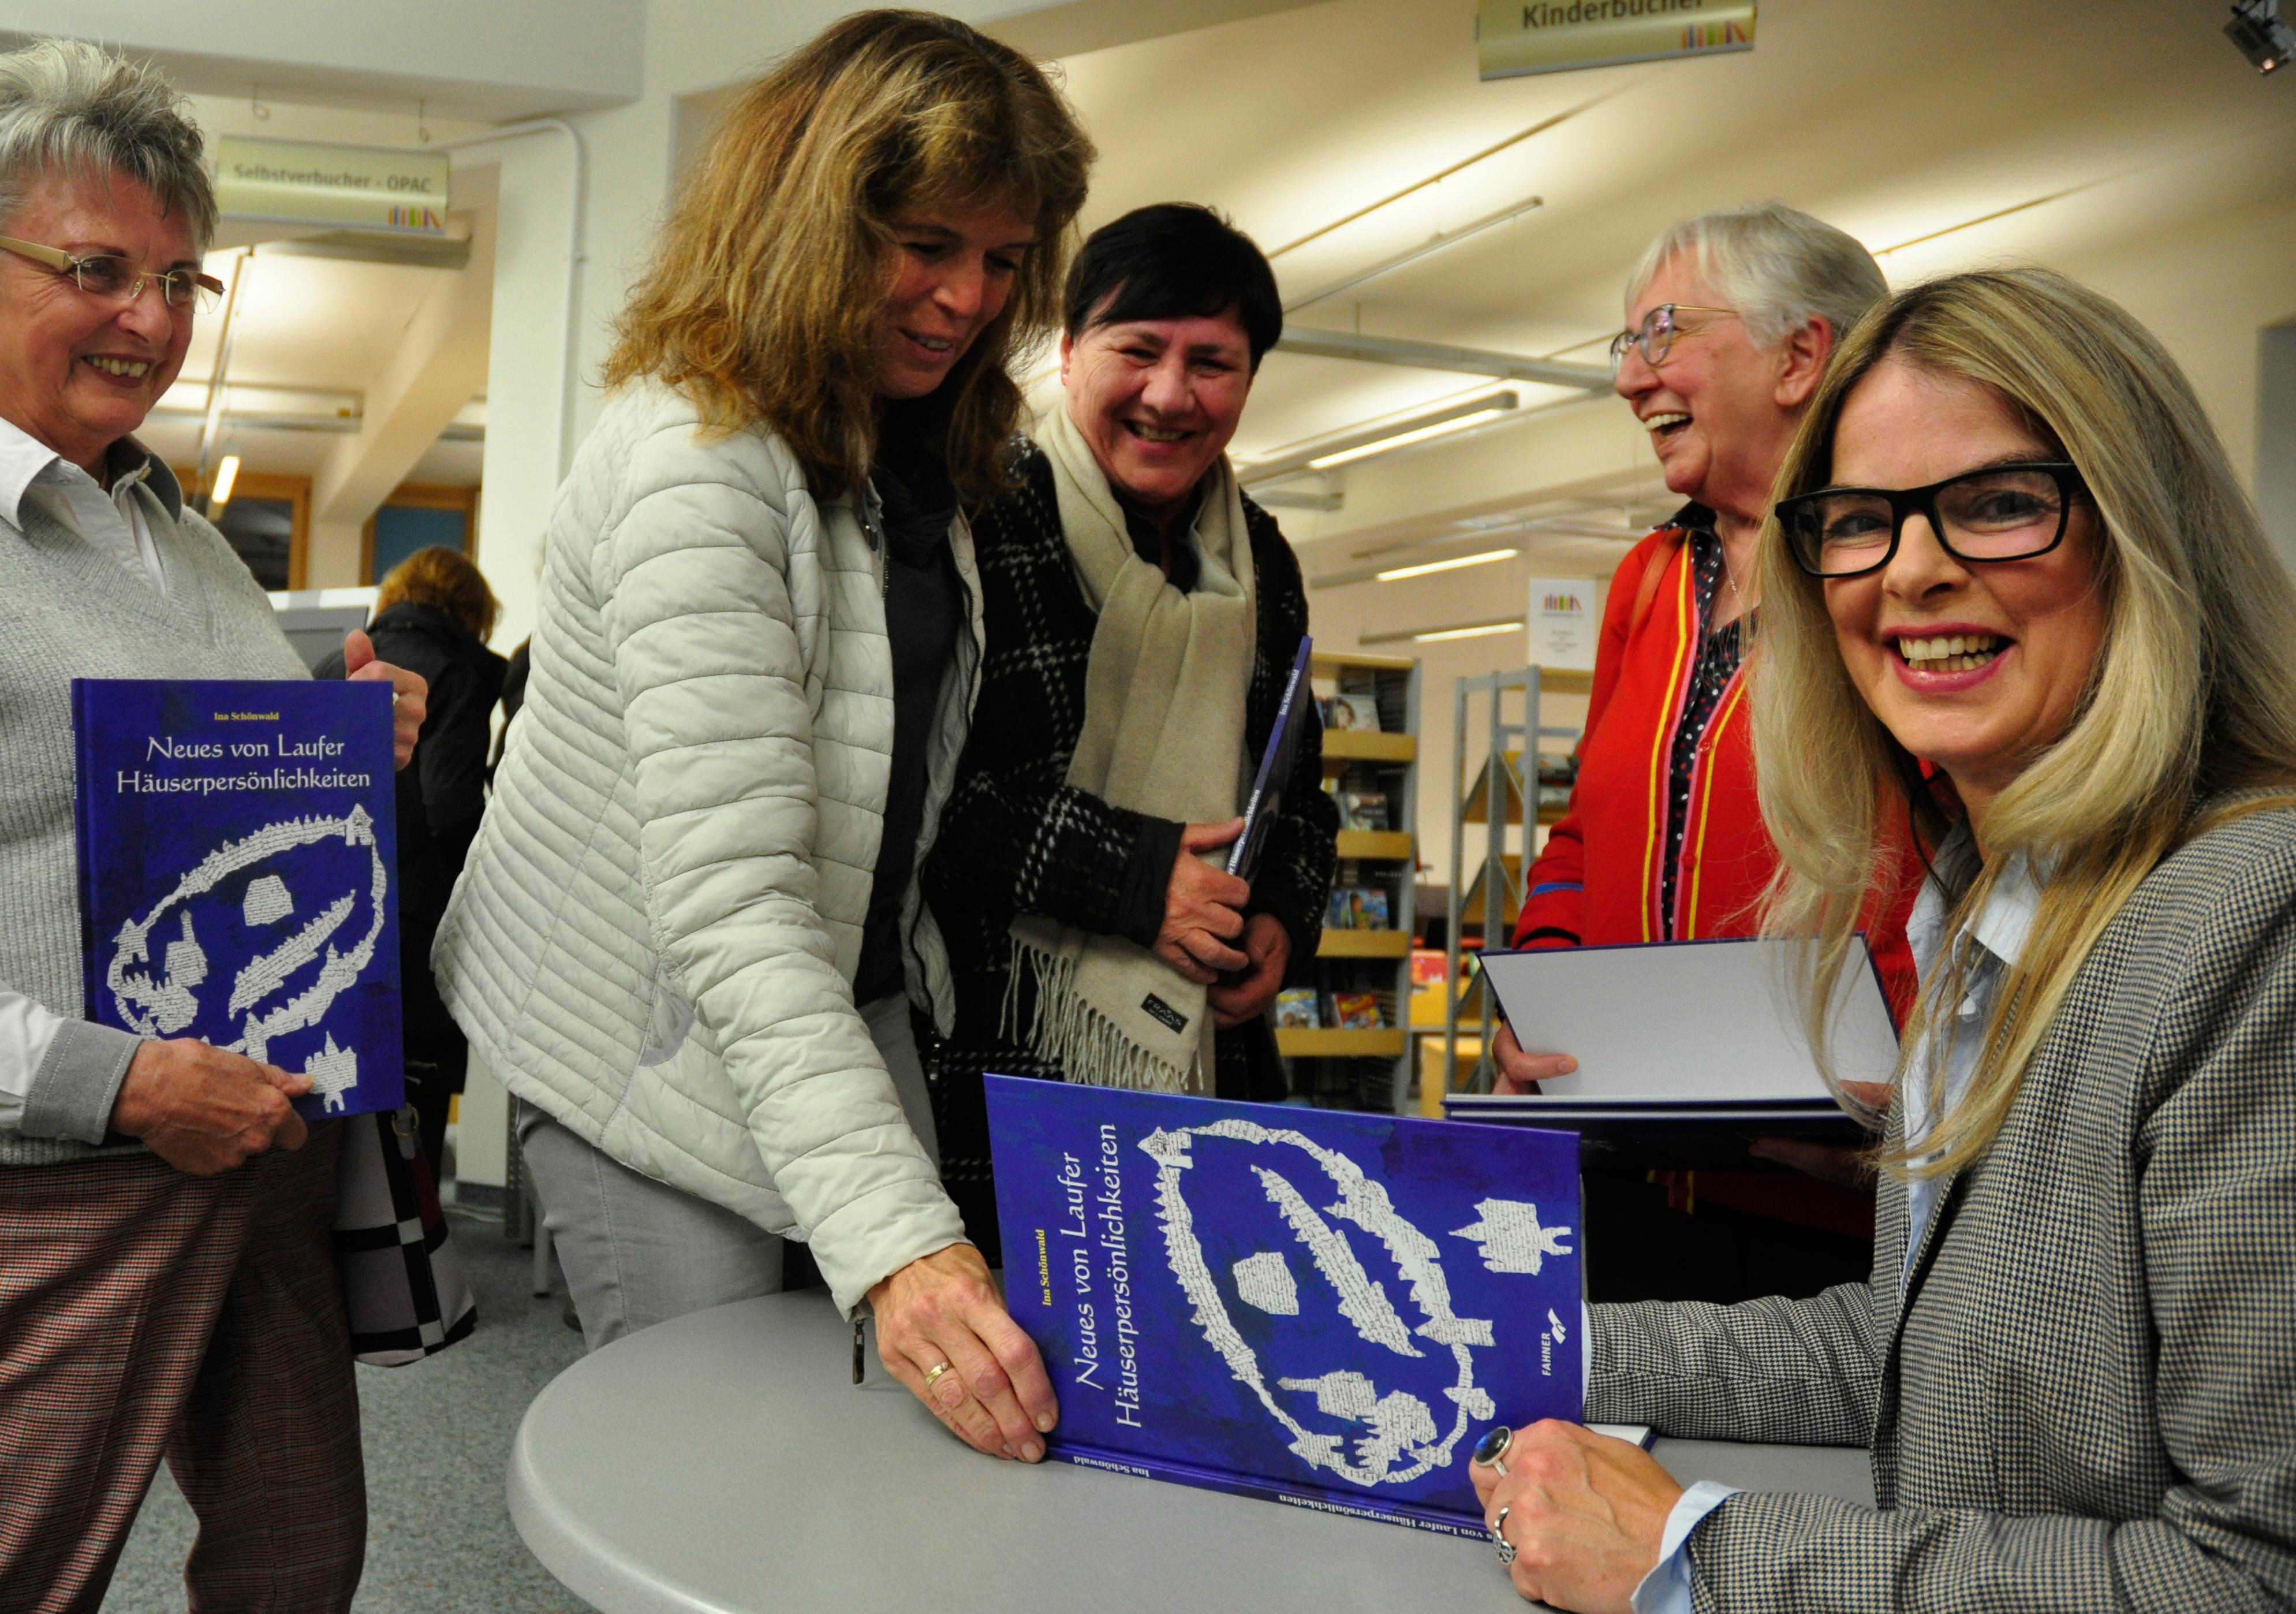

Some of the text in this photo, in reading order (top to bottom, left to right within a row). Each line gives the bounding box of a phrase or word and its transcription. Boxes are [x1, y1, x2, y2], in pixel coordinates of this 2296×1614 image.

[234, 163, 371, 189] Selbstverbucher
[387, 177, 431, 193] OPAC
[1279, 669, 1300, 715] Ina Schönwald
[214, 711, 280, 721] Ina Schönwald
[146, 733, 345, 762] Neues von Laufer
[117, 766, 371, 796] Häuserpersönlichkeiten
[1035, 1228, 1052, 1306] Ina Schönwald
[1057, 1151, 1104, 1391] Neues von Laufer
[1095, 1123, 1142, 1427] Häuserpersönlichkeiten
[1541, 1332, 1552, 1376] FAHNER
[1073, 1455, 1149, 1478] Ina Schönwald
[1279, 1494, 1416, 1527] Häuserpersönlichkeiten
[1418, 1520, 1458, 1535] Laufer
[1461, 1529, 1483, 1538] von
